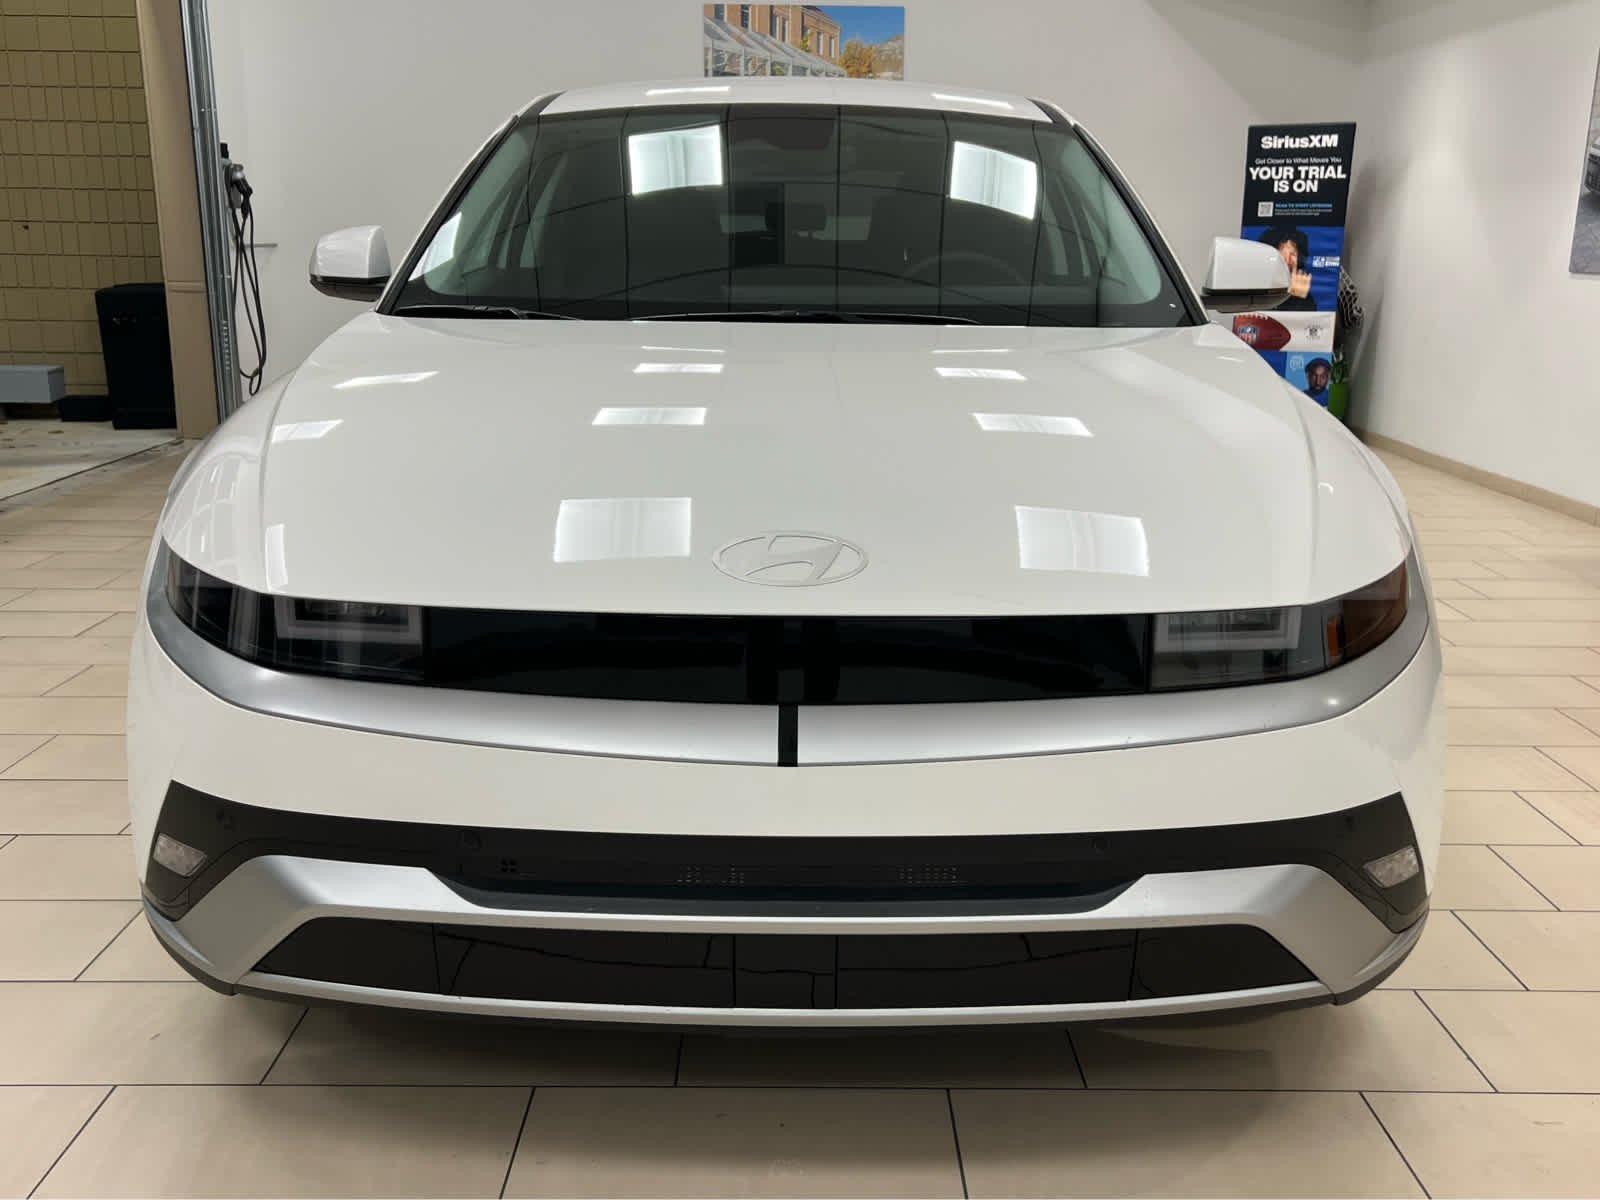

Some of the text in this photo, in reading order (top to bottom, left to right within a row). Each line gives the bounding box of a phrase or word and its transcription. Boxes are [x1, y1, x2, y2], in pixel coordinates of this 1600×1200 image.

[1261, 134, 1338, 149] SiriusXM
[1249, 166, 1346, 180] YOUR TRIAL
[1274, 180, 1318, 193] IS ON
